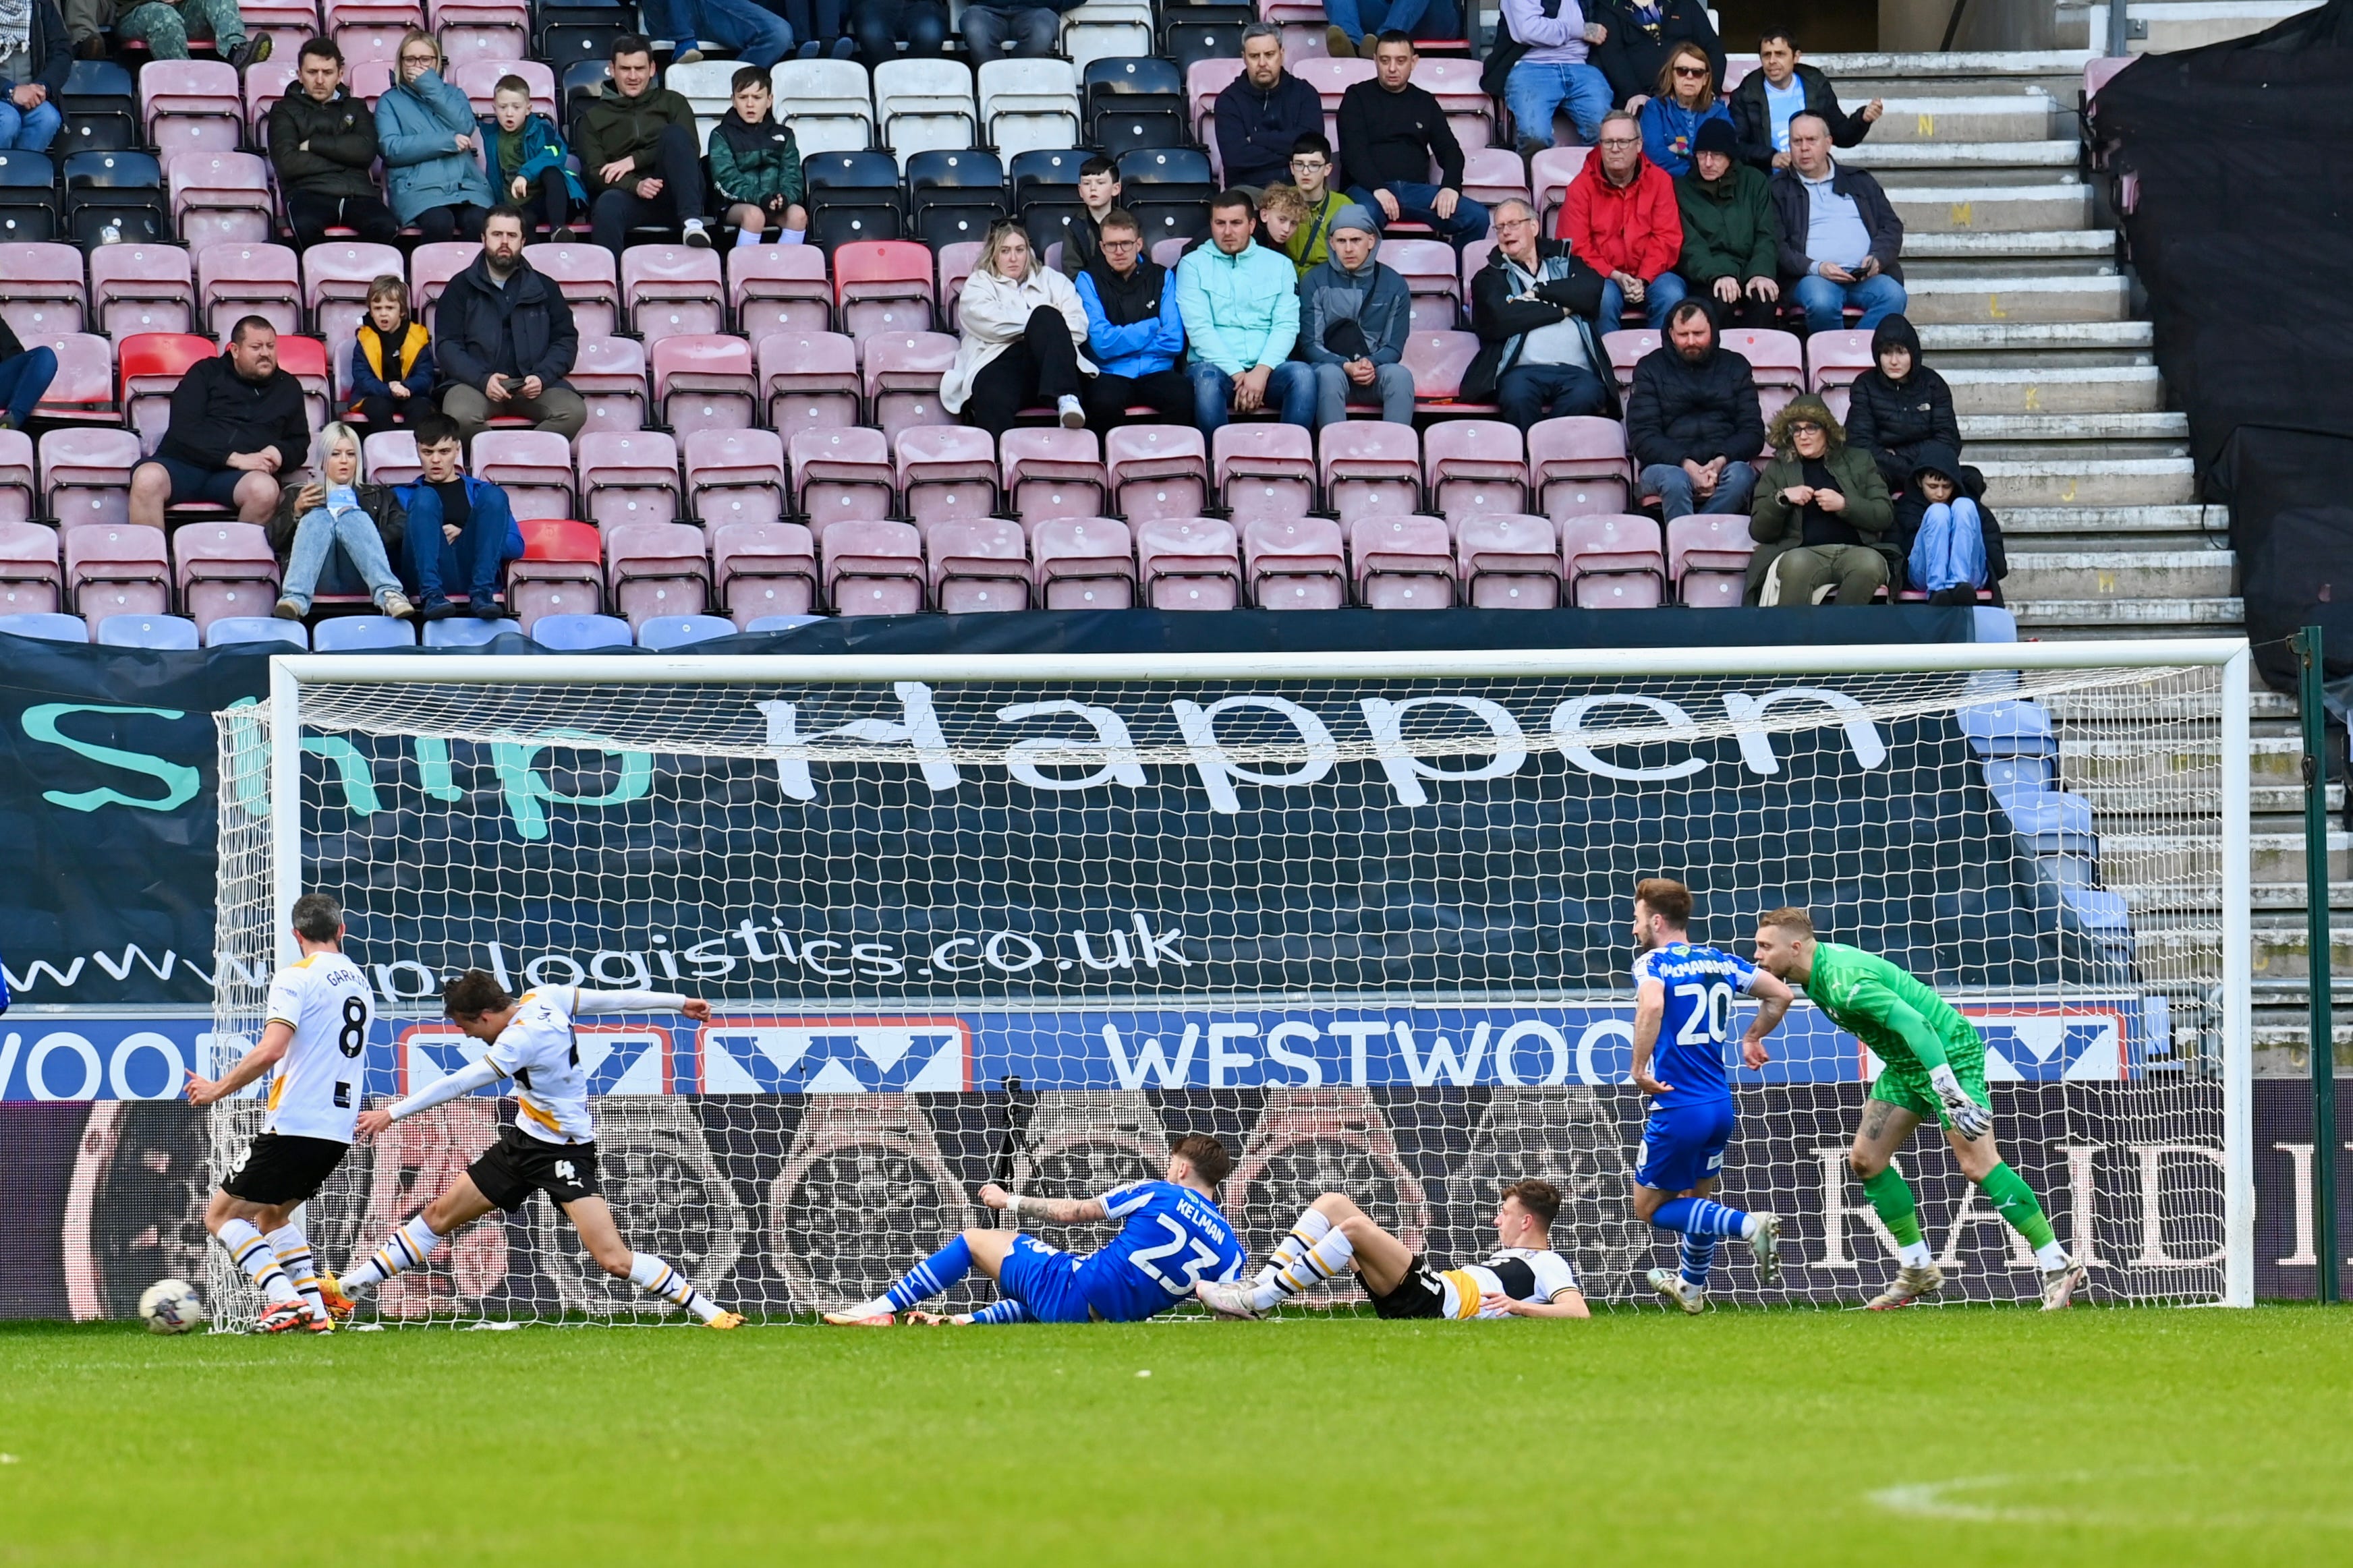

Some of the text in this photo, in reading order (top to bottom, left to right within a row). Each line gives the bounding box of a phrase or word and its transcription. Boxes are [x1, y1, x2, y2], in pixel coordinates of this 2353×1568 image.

[1918, 114, 1933, 136] N
[1990, 294, 2006, 318] L
[21, 681, 1887, 840] Ship Happen
[339, 996, 366, 1058] 8
[1674, 982, 1733, 1045] 20
[1101, 1019, 1637, 1088] WESTWOO
[231, 1146, 252, 1173] 8
[555, 1159, 575, 1180] 4
[1176, 1198, 1225, 1246] KELMAN
[1128, 1212, 1221, 1296] 23
